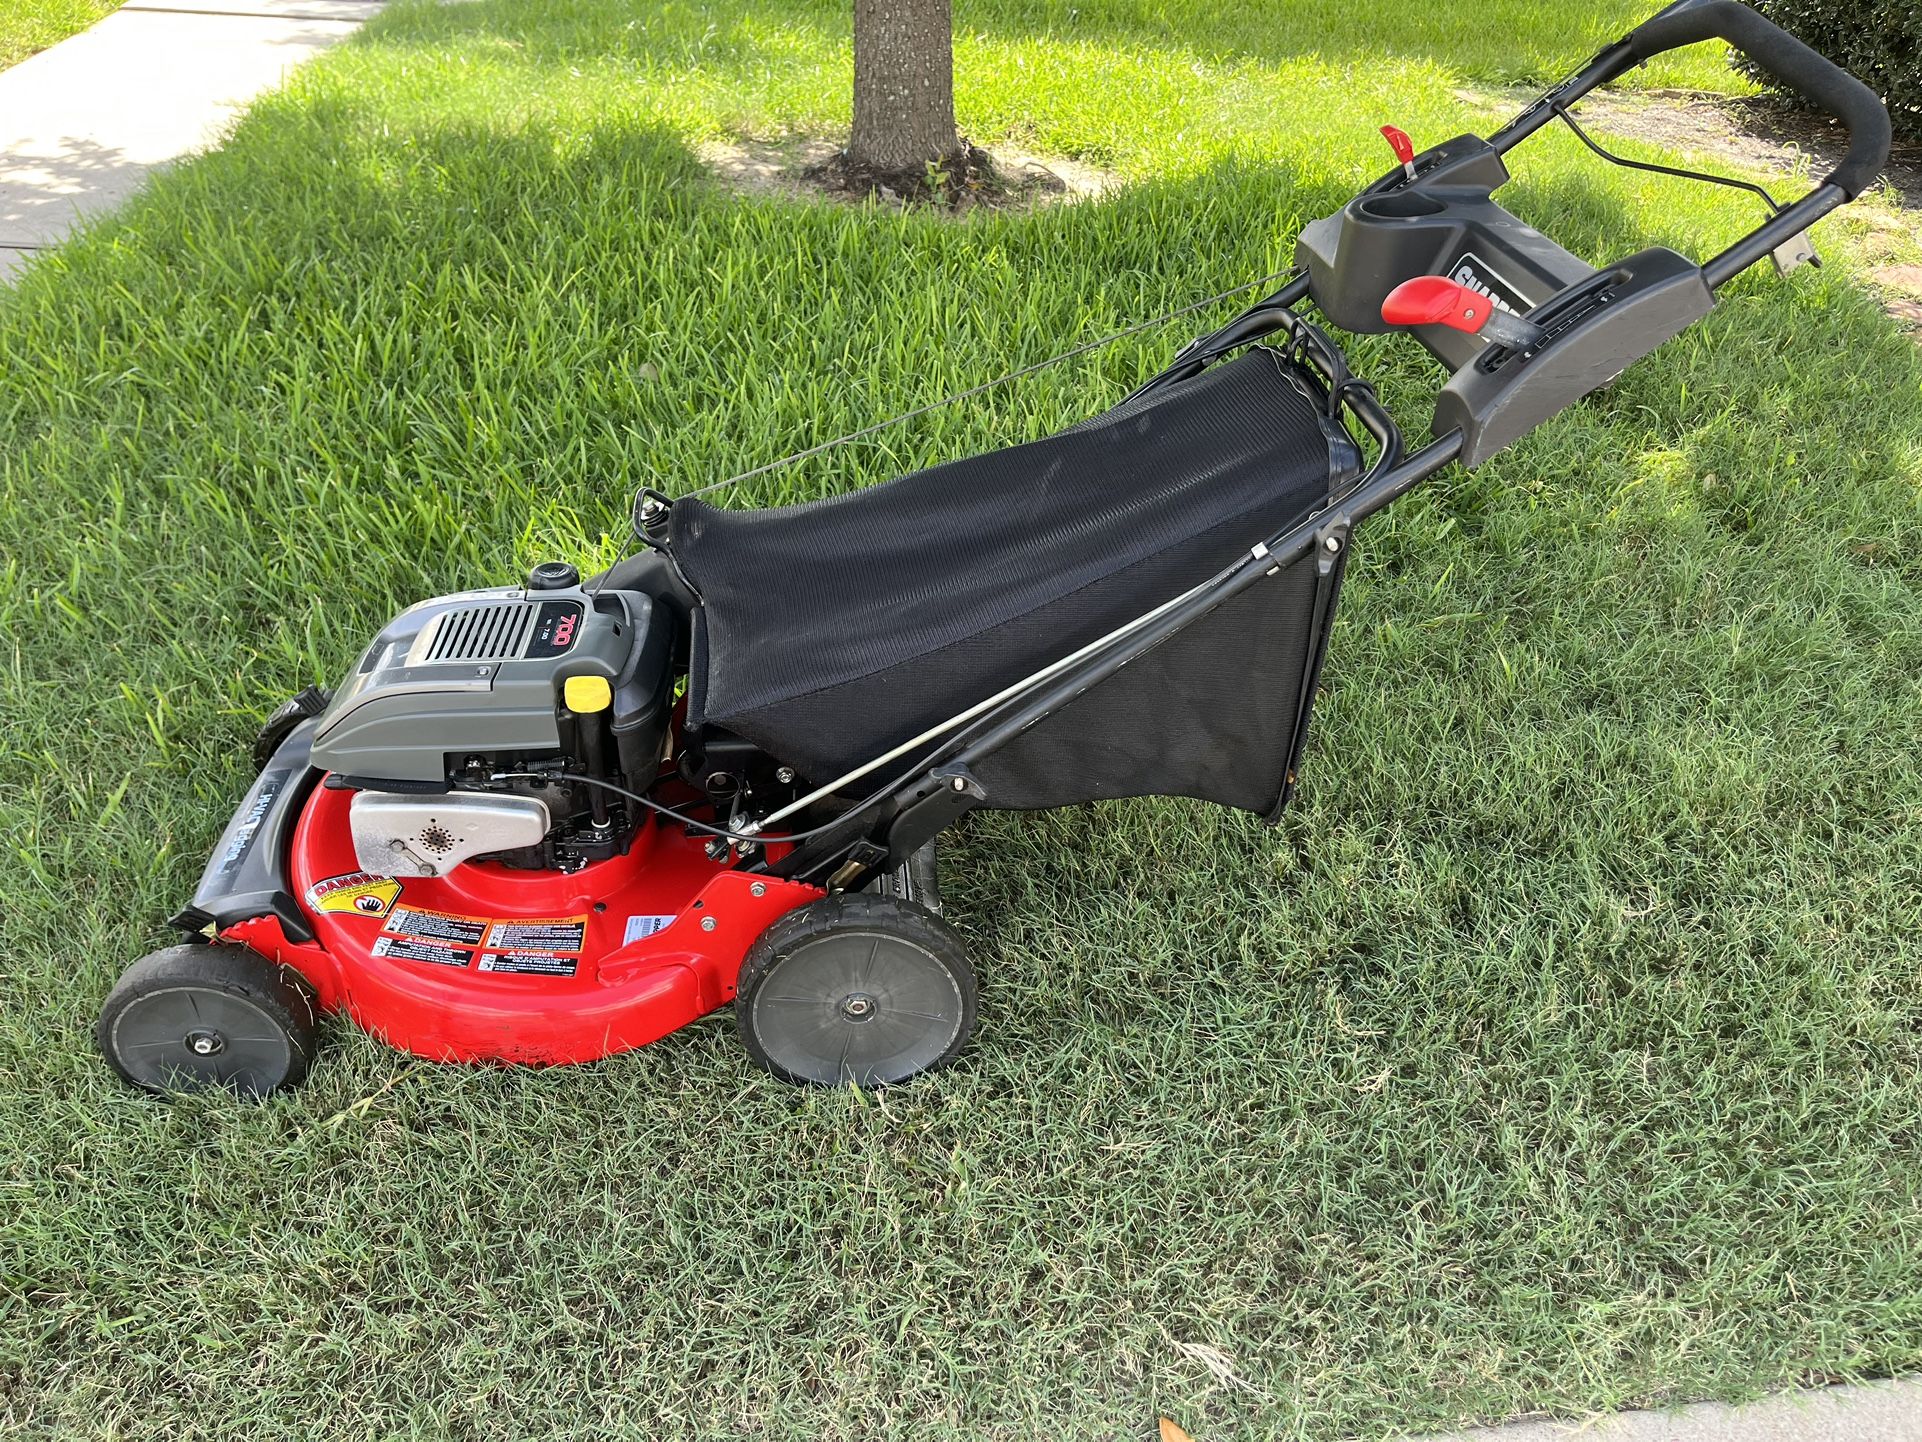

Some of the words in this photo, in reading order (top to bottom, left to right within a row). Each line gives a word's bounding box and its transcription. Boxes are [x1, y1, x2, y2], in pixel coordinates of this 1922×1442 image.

[1455, 265, 1521, 318] SNAPP
[553, 613, 577, 646] 700
[314, 873, 385, 898] DANGER
[427, 910, 467, 920] WARNING
[414, 937, 452, 948] DANGER
